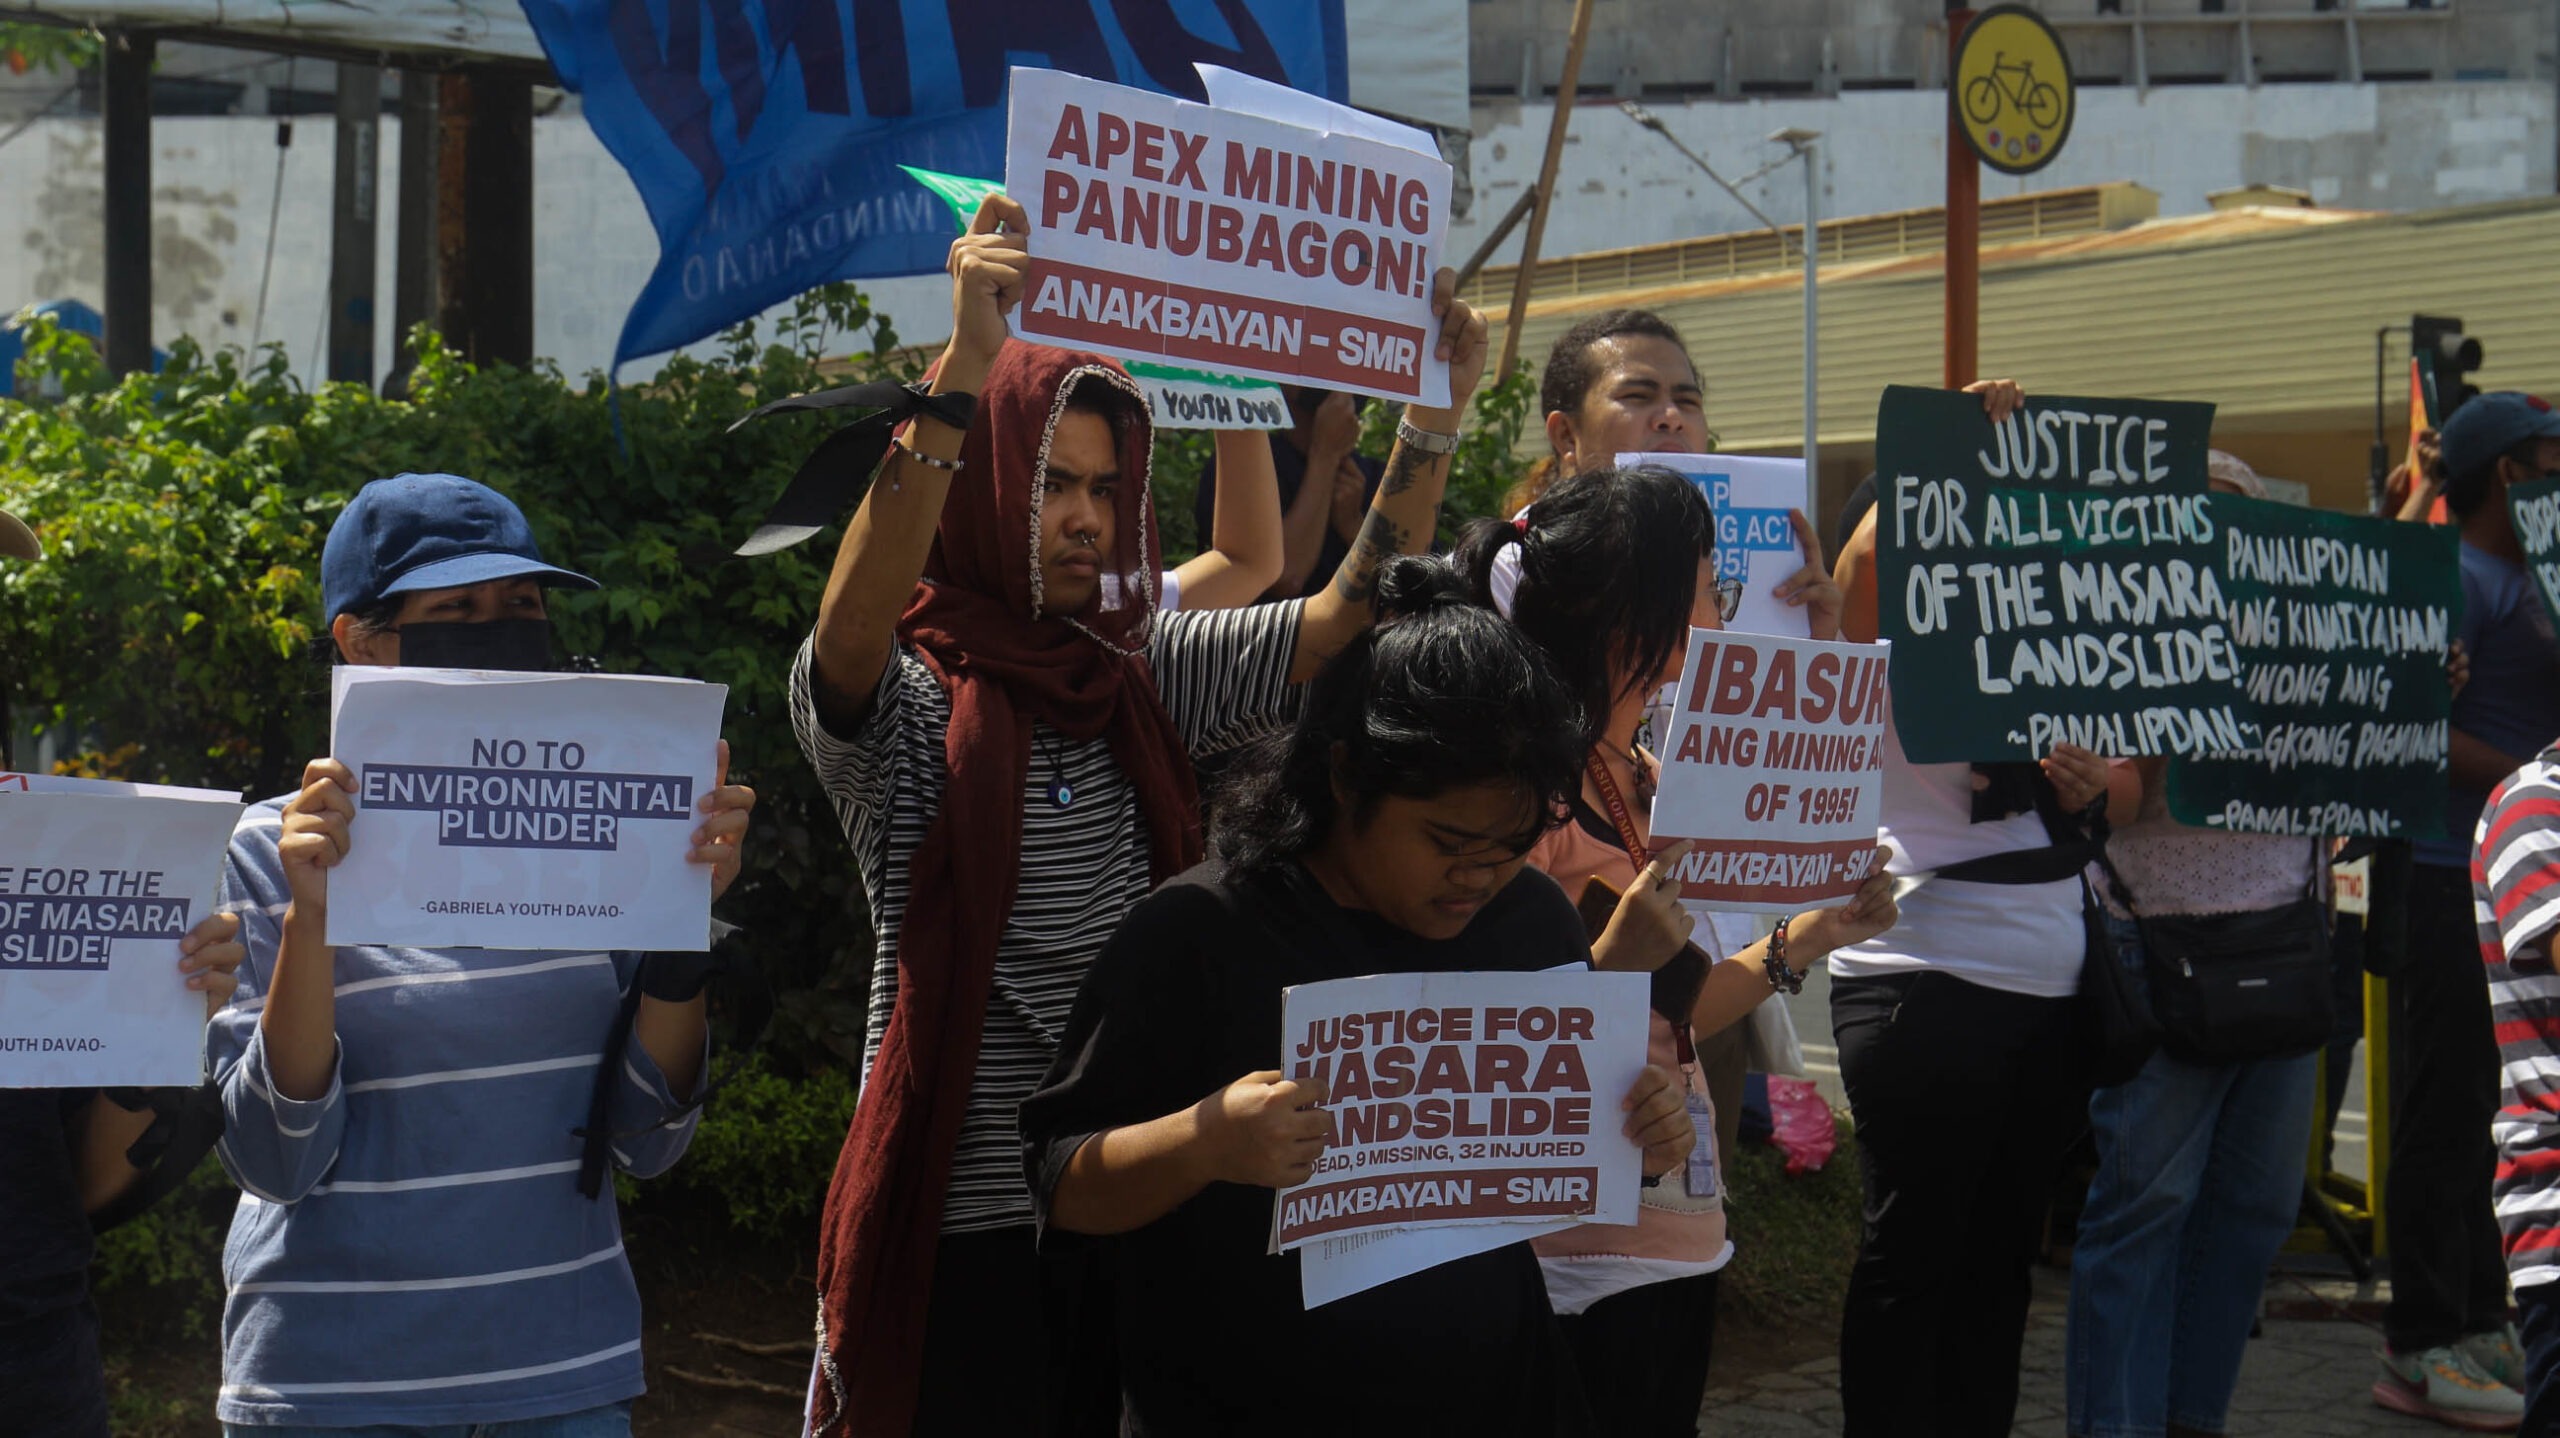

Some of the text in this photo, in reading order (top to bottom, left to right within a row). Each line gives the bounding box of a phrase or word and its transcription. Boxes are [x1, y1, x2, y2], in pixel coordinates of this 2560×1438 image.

[1047, 102, 1210, 193] APEX
[1223, 141, 1430, 236] MINING
[1041, 169, 1427, 299] PANUBAGON!
[1031, 275, 1303, 357] ANAKBAYAN
[1337, 326, 1419, 378] SMR
[1162, 387, 1233, 424] YOUTH
[1978, 409, 2170, 487] JUSTICE
[1744, 515, 1792, 544] ACT
[1895, 473, 2214, 551] FOR ALL VICTIMS
[1713, 548, 1750, 577] 95!
[2227, 526, 2388, 595] PANALIPDAN
[1906, 559, 2229, 635] OF THE MASARA
[1974, 625, 2243, 694] LANDSLIDE!
[1687, 641, 1886, 726] IBASUR
[2339, 663, 2393, 712] ANG
[471, 738, 585, 770] NO TO
[1675, 724, 1759, 768] ANG
[1763, 730, 1866, 773] MINING
[362, 771, 690, 813] ENVIRONMENTAL
[1744, 783, 1860, 825] OF 1995!
[441, 809, 616, 843] PLUNDER
[20, 868, 89, 896] FOR
[99, 870, 164, 897] THE
[1843, 849, 1876, 881] SM
[40, 902, 186, 933] MASARA
[510, 902, 562, 917] YOUTH
[1, 934, 111, 964] SLIDE!
[0, 1038, 38, 1052] UTH
[1297, 1006, 1595, 1059] JUSTICE FOR
[1322, 1097, 1591, 1150] ANDSLIDE
[1356, 1151, 1366, 1167] 9
[1368, 1145, 1454, 1165] MISSING,
[1459, 1144, 1486, 1160] 32
[1490, 1141, 1585, 1158] INJURED
[1282, 1179, 1472, 1232] ANAKBAYAN
[1506, 1176, 1590, 1203] SMR
